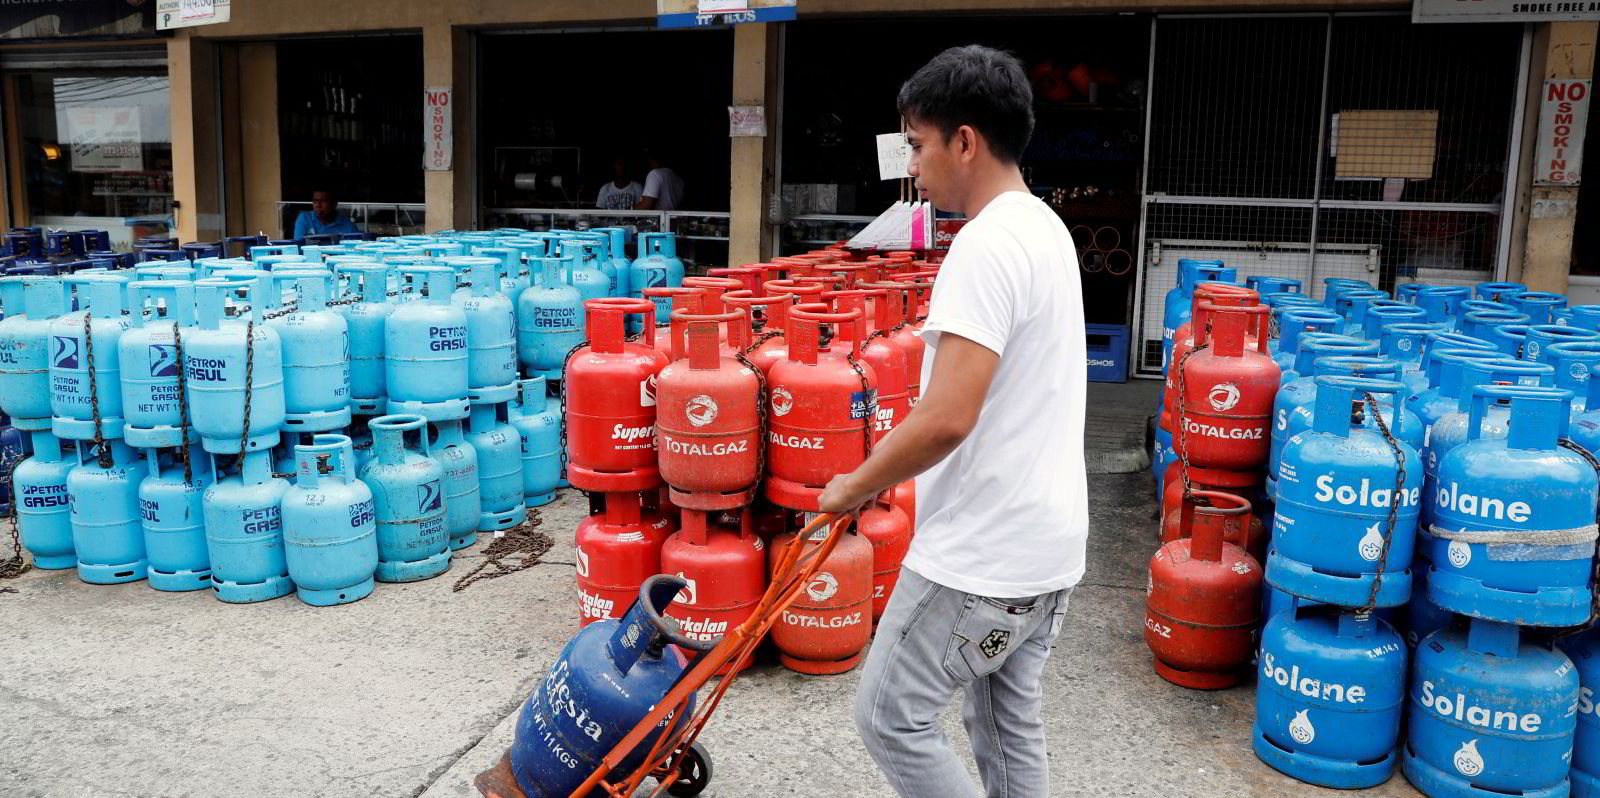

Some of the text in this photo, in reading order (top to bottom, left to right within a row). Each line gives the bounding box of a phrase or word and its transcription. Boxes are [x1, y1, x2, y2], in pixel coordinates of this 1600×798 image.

[1512, 3, 1552, 13] SMOKE
[1557, 3, 1584, 12] FREE
[427, 92, 449, 106] NO
[1547, 82, 1585, 102] NO
[433, 106, 444, 167] SMOKING
[1549, 102, 1573, 182] SMOKING
[534, 306, 575, 318] PETRON
[534, 318, 575, 328] GASUL
[54, 376, 79, 385] PETRON
[54, 385, 79, 393] GASUL
[138, 404, 154, 413] NET
[157, 404, 170, 412] WT
[1183, 417, 1263, 440] TOTALGAZ
[664, 436, 748, 456] TOTALGAZ
[104, 468, 126, 477] 15.4
[306, 494, 326, 503] 12.3
[1314, 474, 1419, 508] Solane
[782, 610, 863, 629] TOTALGAZ
[1366, 643, 1399, 659] T.W.14.9
[1263, 654, 1366, 704] Solane
[1421, 680, 1542, 733] Solane
[552, 744, 578, 769] KGS
